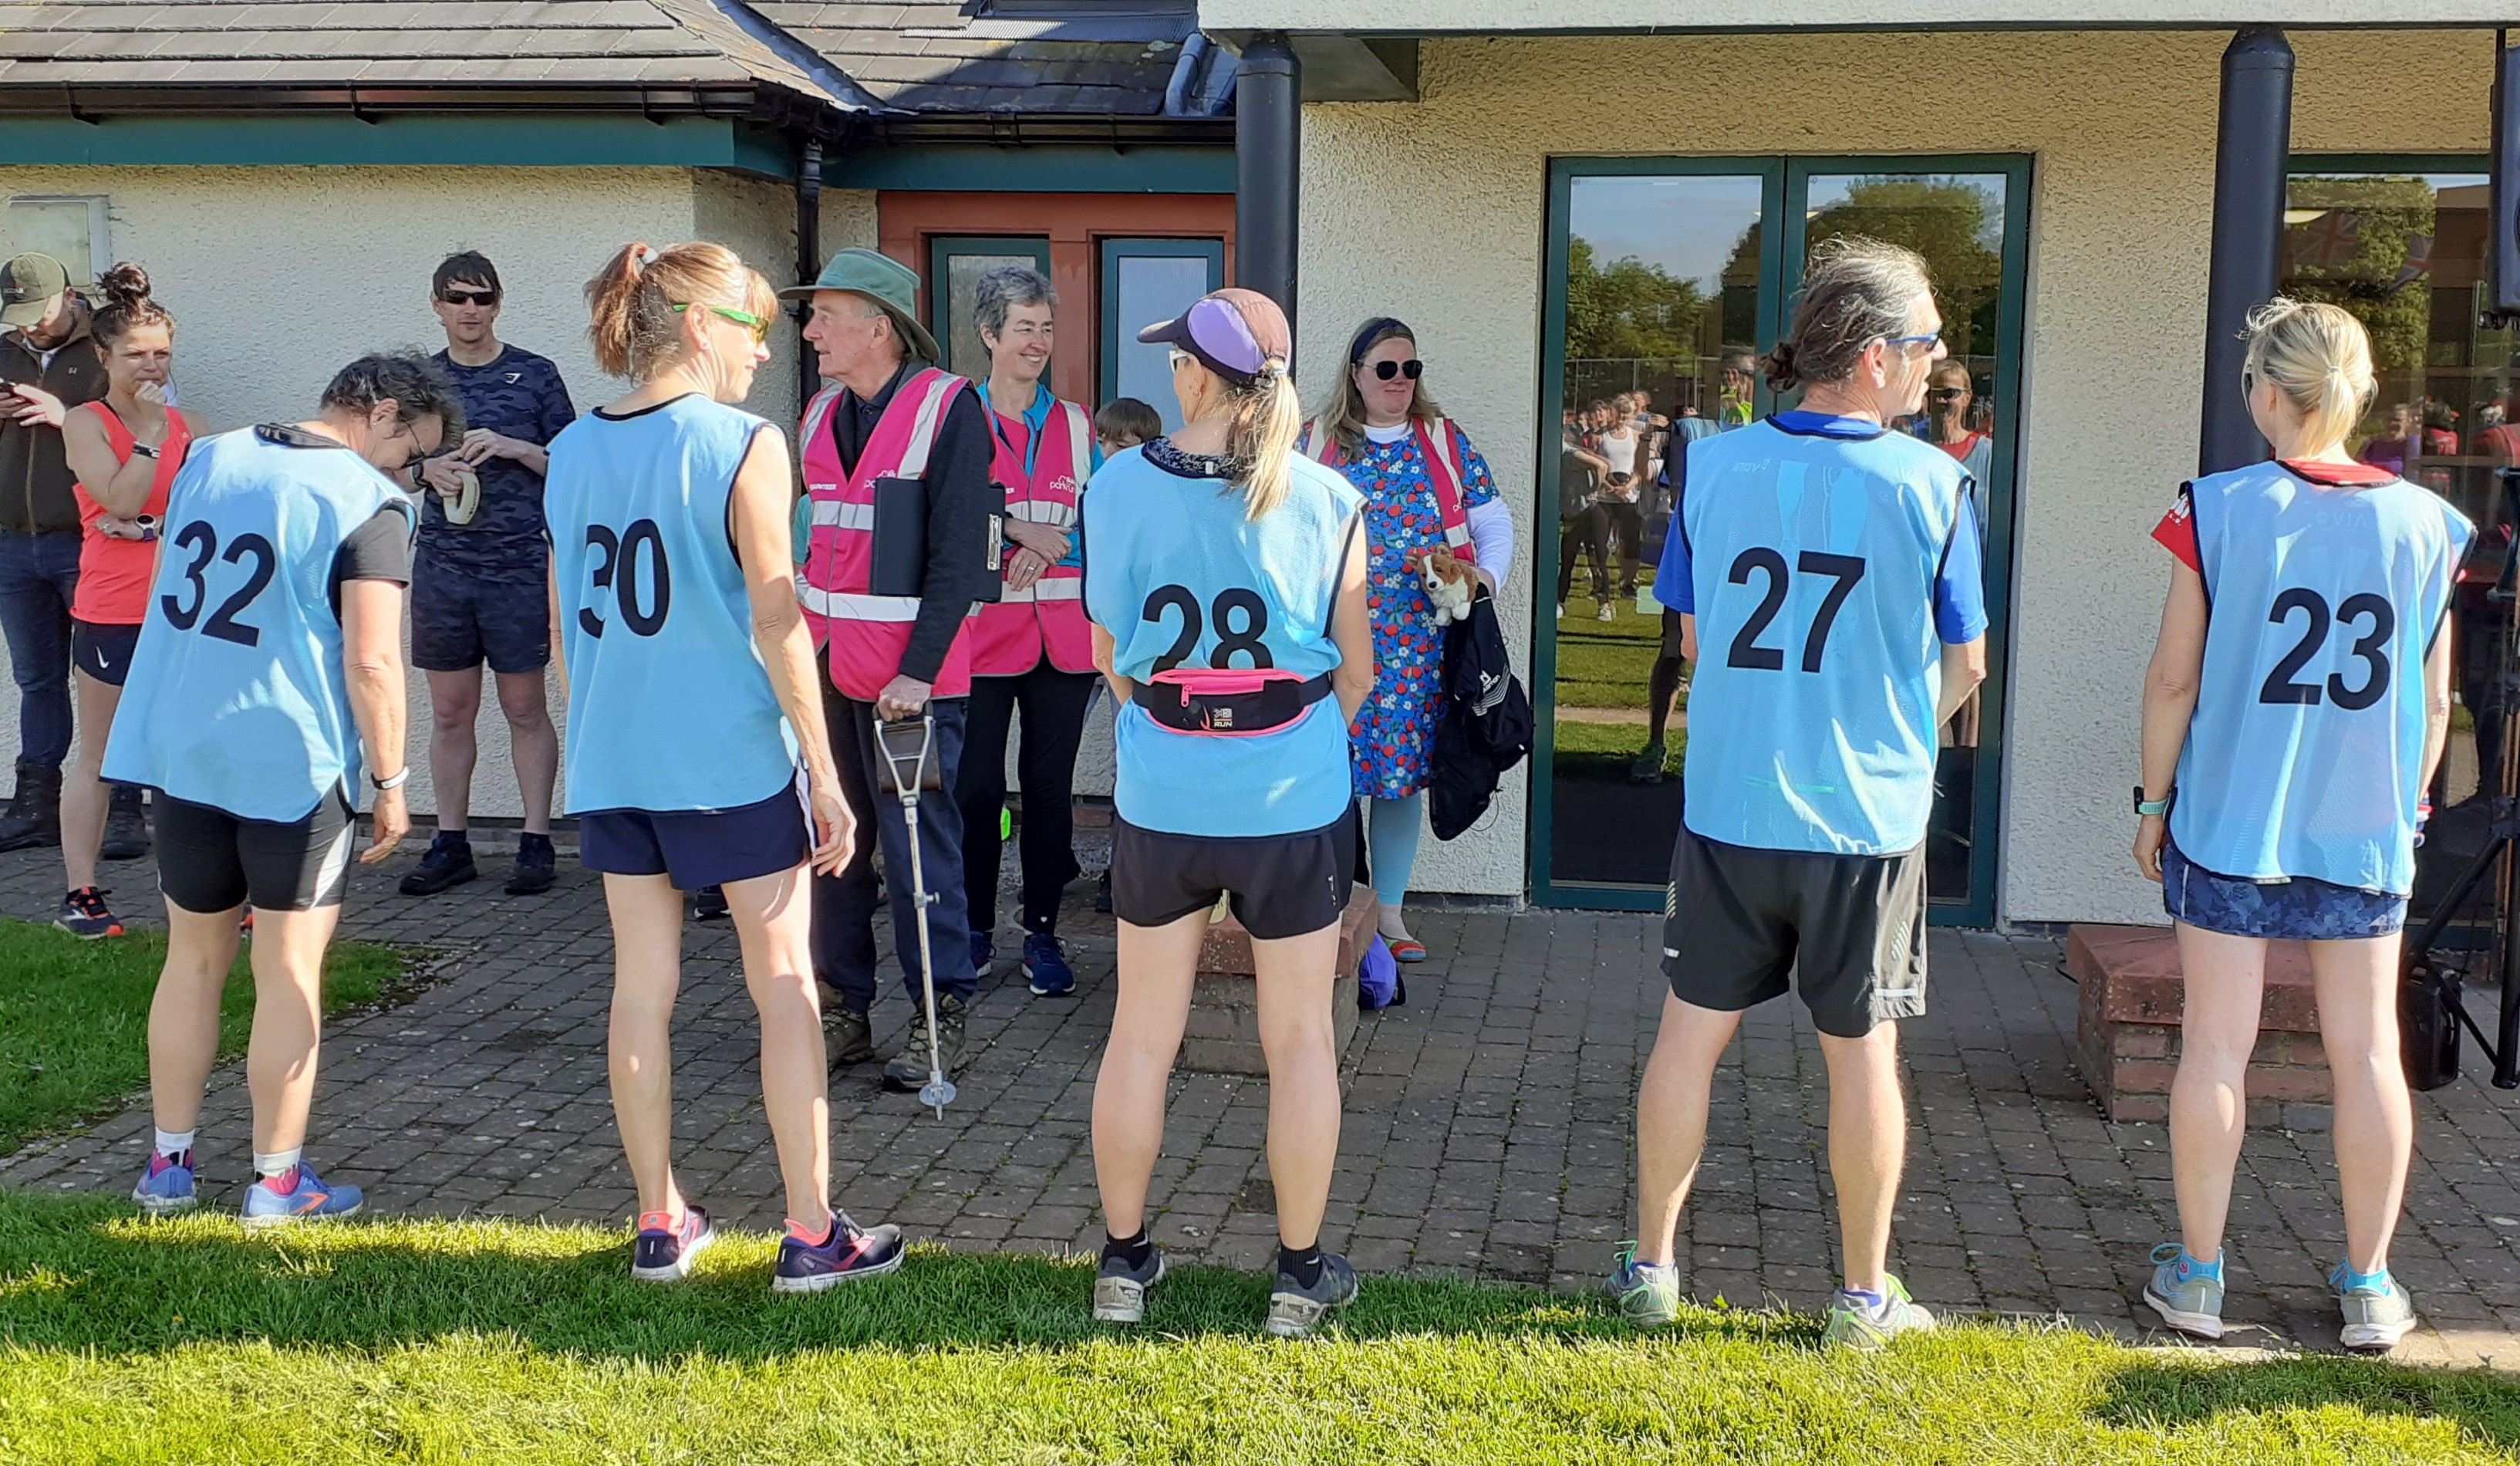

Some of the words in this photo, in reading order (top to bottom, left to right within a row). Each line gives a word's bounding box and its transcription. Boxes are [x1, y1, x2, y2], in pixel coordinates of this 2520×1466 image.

[163, 521, 275, 647] 32
[579, 519, 670, 639] 30
[1142, 584, 1273, 677] 28
[1727, 547, 1865, 672] 27
[2259, 587, 2394, 711] 23
